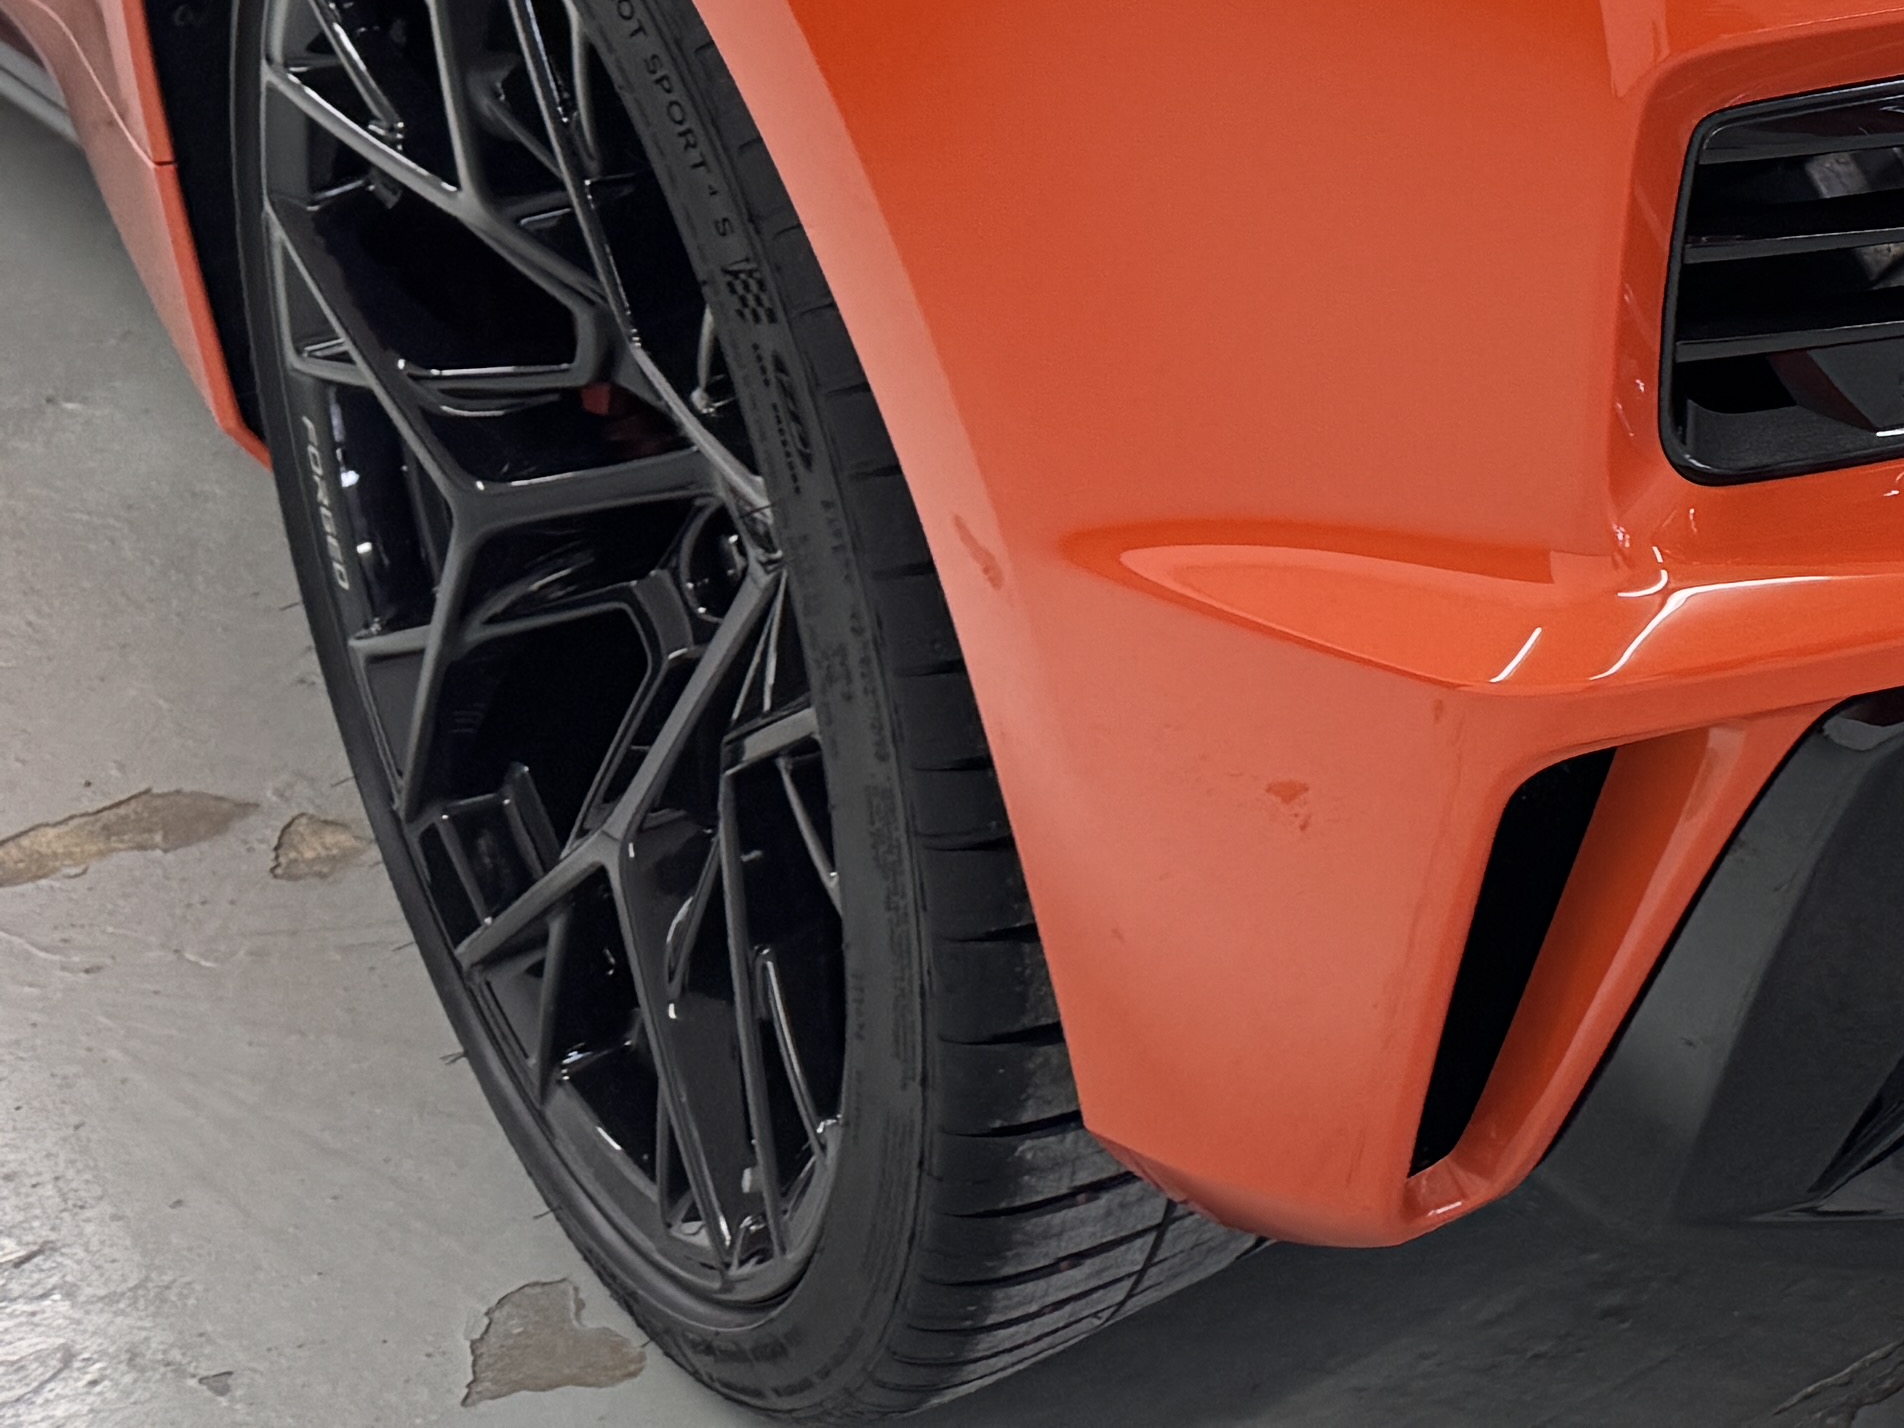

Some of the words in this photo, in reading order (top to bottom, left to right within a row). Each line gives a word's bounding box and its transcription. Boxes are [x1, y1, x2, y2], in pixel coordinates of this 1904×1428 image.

[643, 52, 710, 175] SPORT
[707, 184, 719, 198] 4
[714, 217, 735, 239] S
